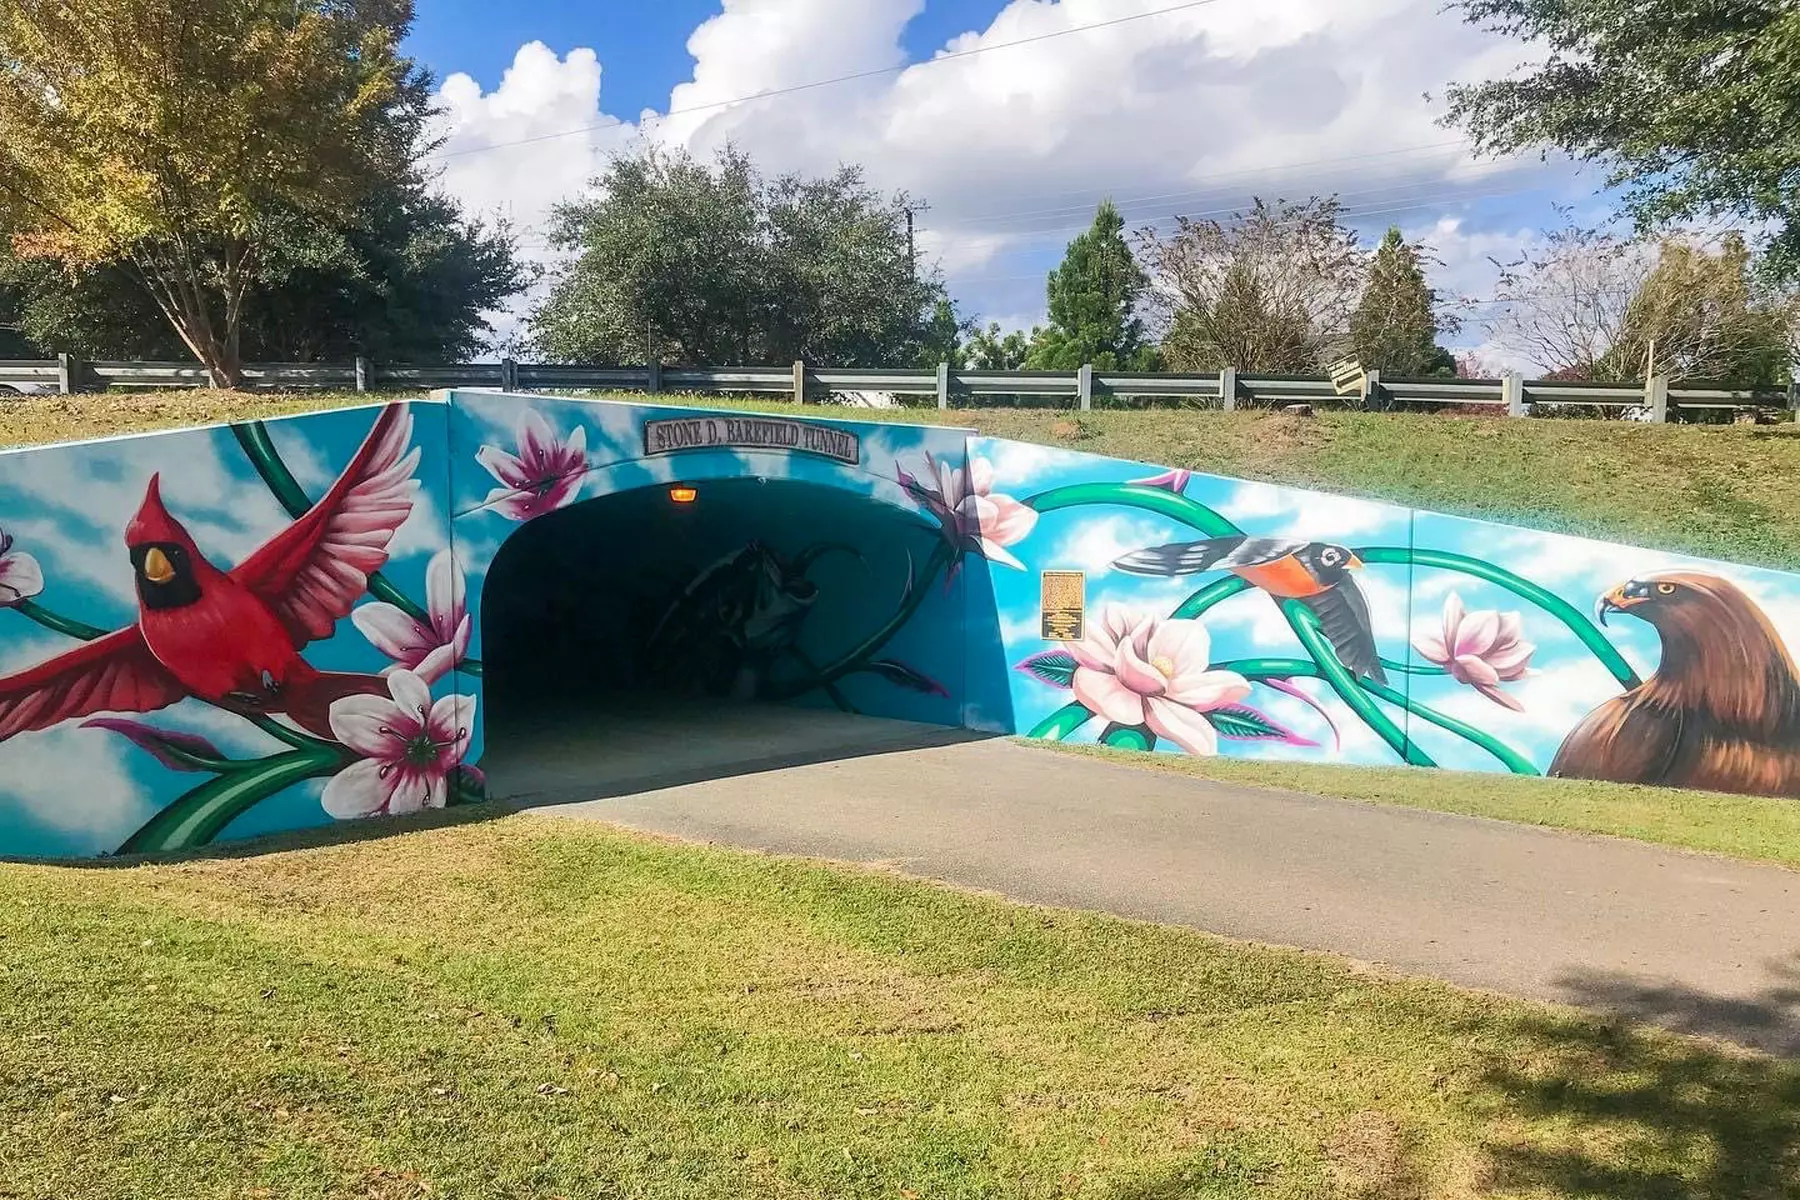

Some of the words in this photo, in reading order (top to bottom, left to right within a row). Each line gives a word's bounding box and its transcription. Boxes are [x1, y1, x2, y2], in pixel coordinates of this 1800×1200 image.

[656, 421, 702, 449] STONE
[726, 419, 799, 446] BAREFIELD
[803, 427, 851, 458] TUNNEL
